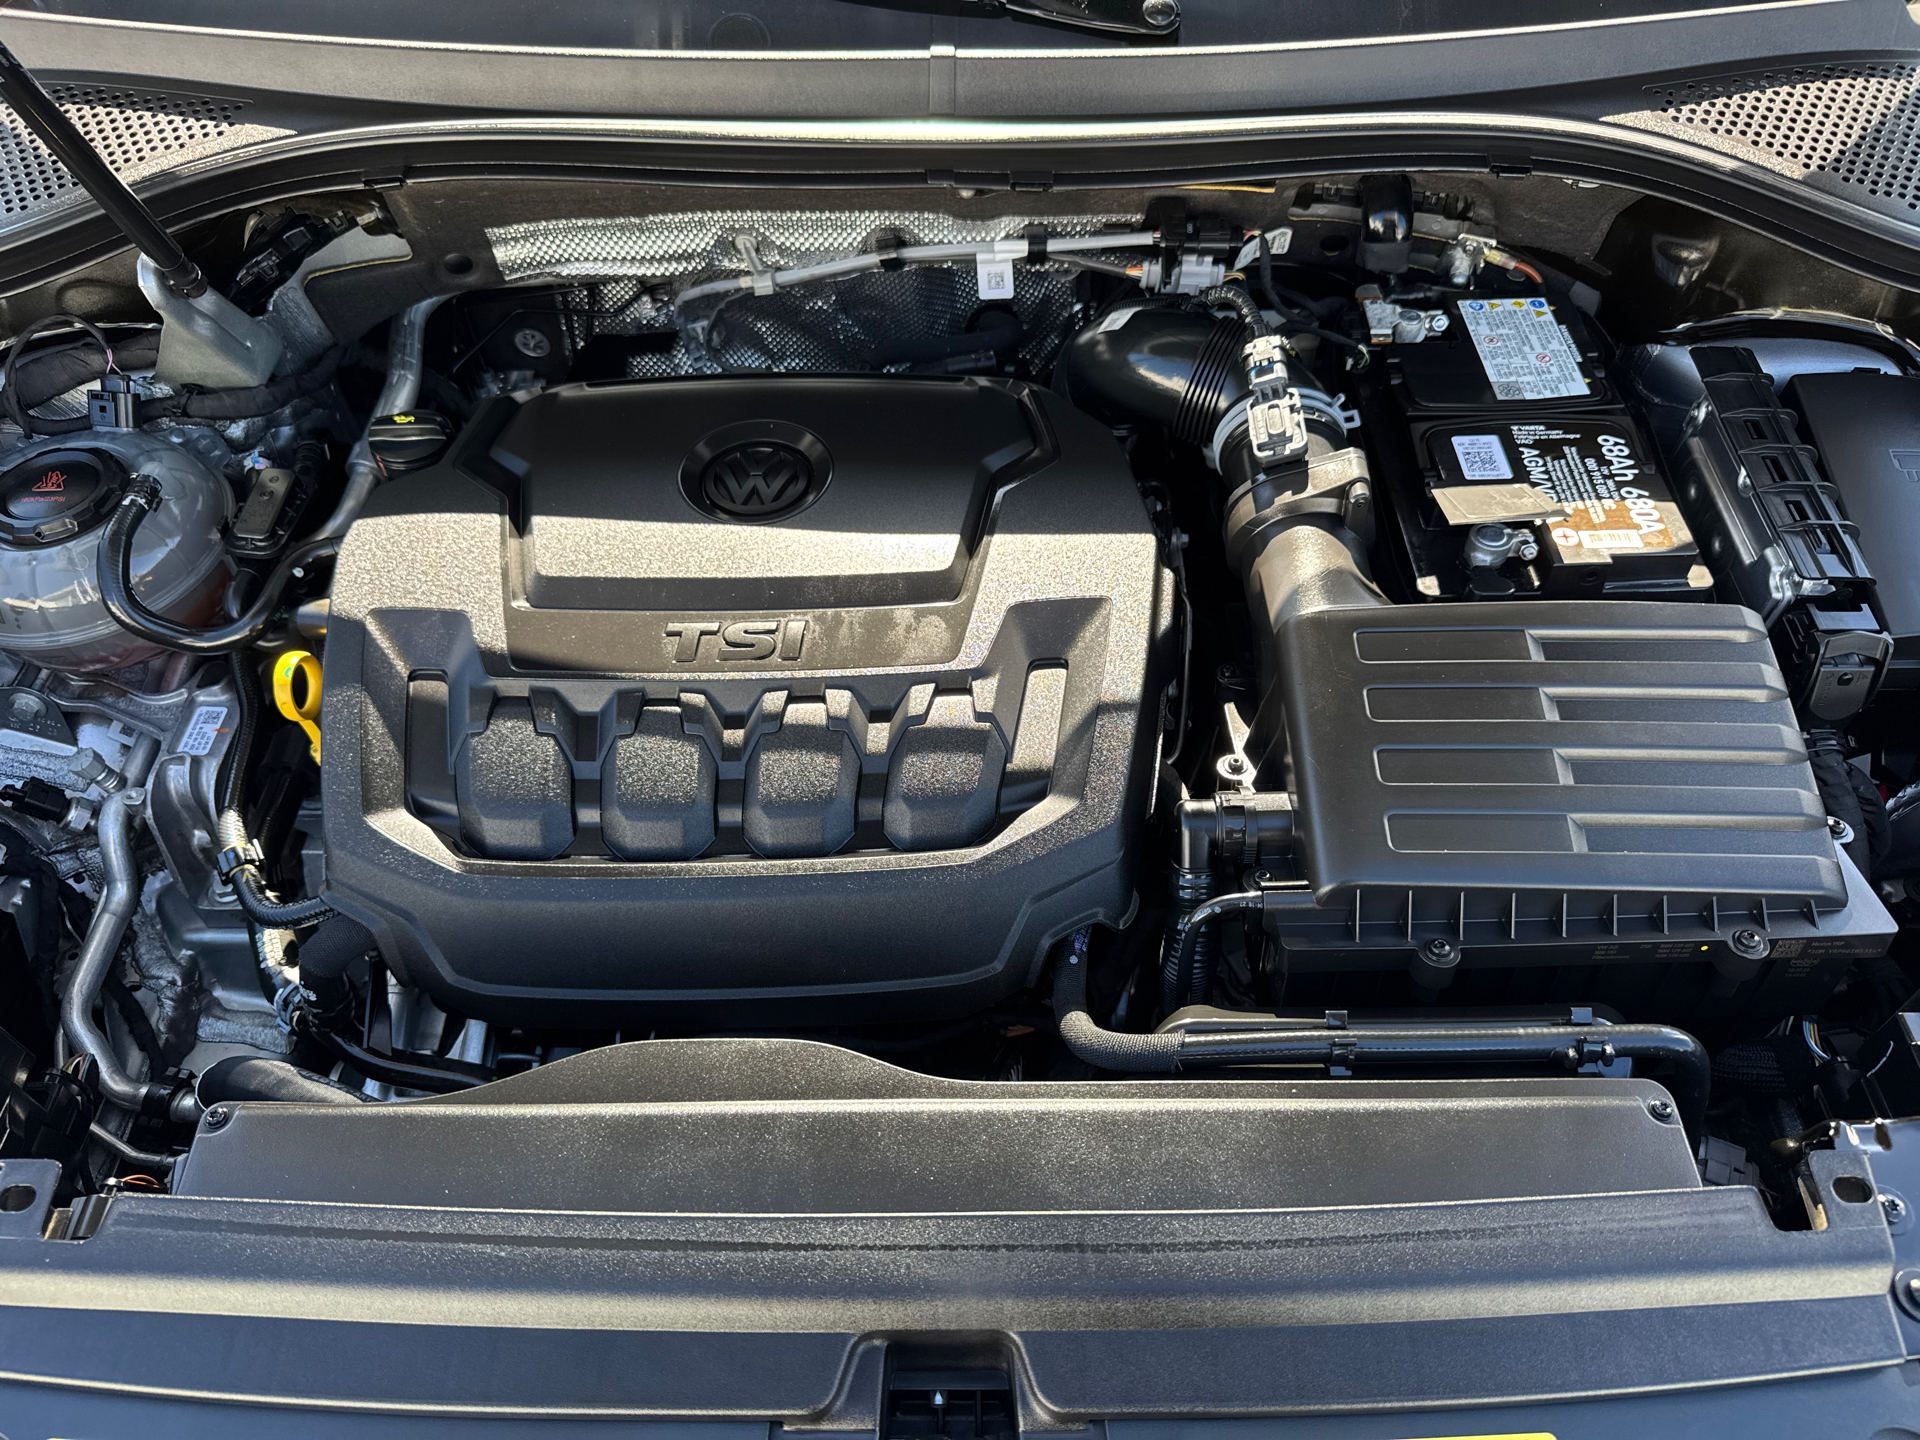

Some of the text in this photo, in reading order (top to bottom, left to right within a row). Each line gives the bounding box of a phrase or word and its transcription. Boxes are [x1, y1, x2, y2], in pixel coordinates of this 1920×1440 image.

[1584, 457, 1599, 471] 000
[1590, 471, 1605, 484] 915
[1597, 434, 1640, 481] 68Ah
[1620, 486, 1666, 534] 680A
[1596, 484, 1611, 498] 089
[664, 620, 807, 663] TSI
